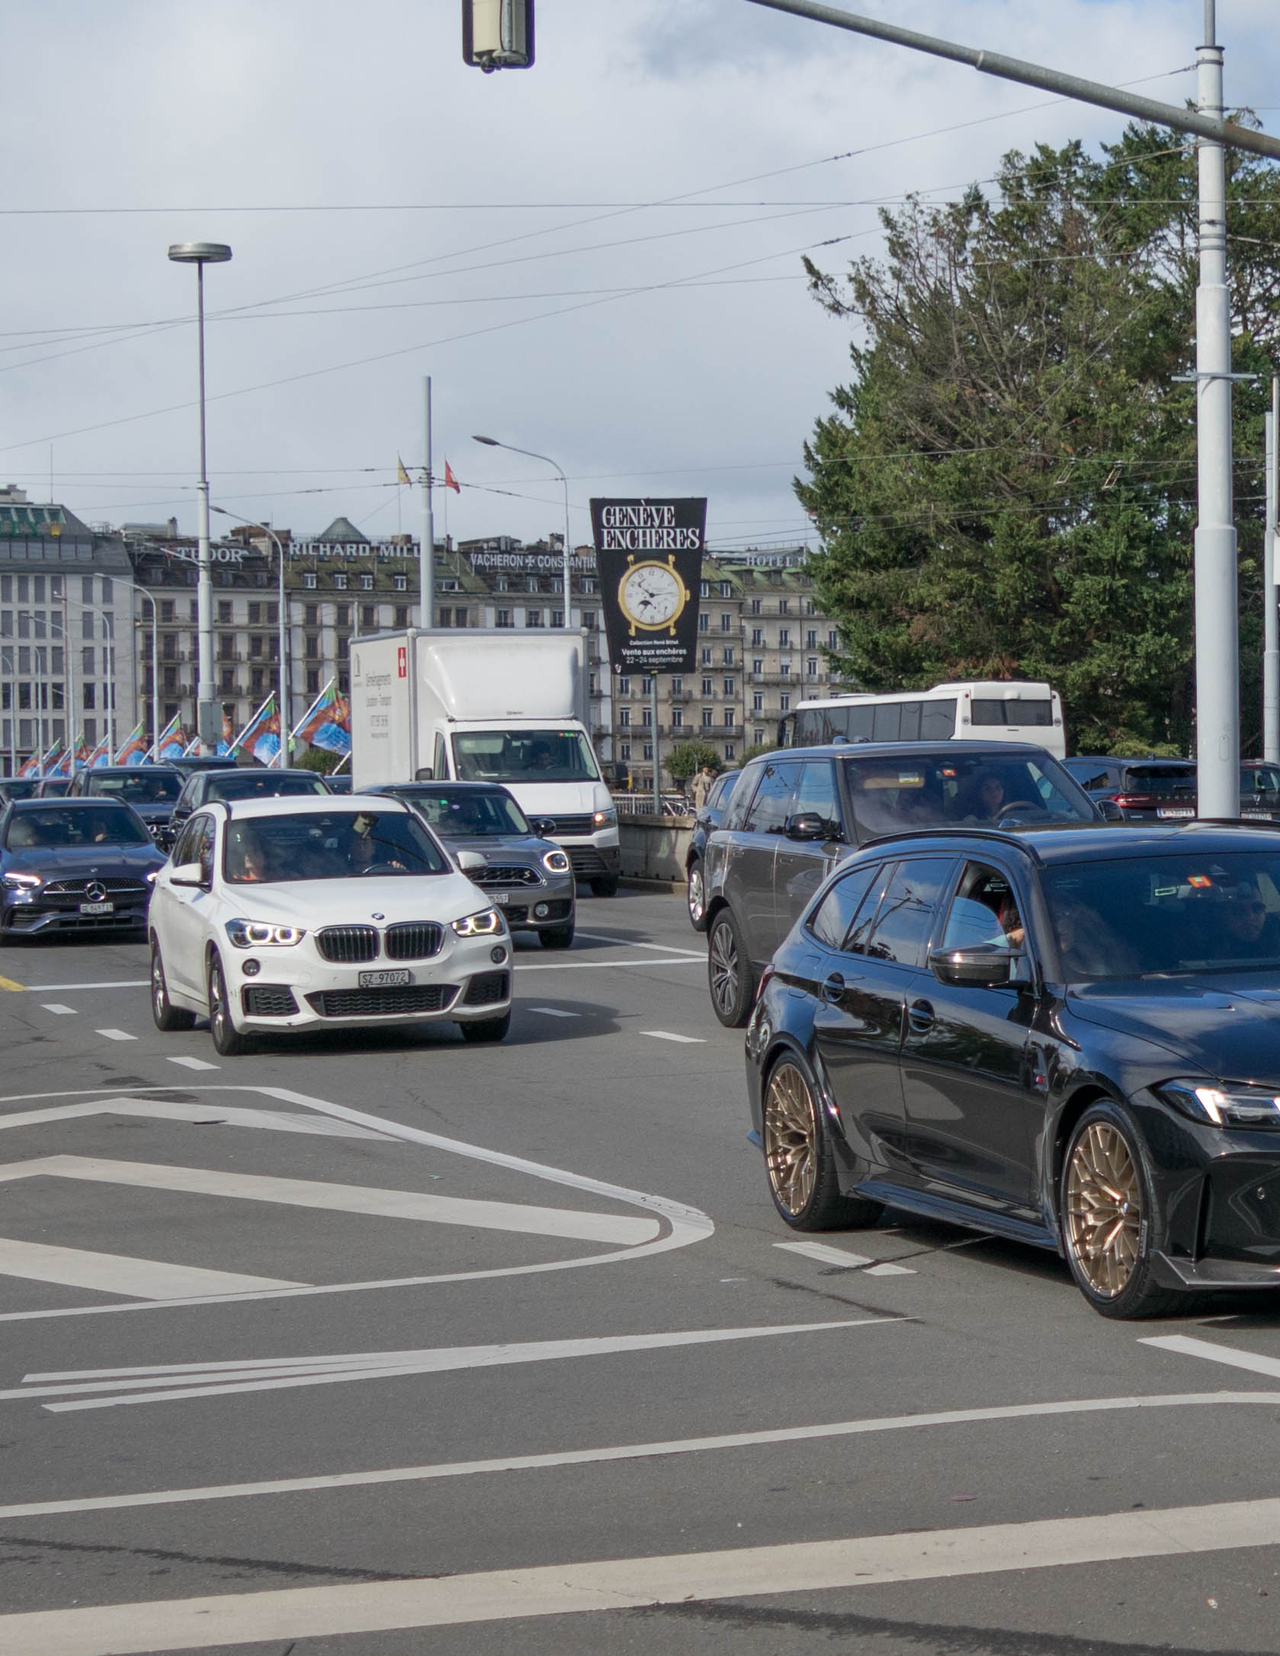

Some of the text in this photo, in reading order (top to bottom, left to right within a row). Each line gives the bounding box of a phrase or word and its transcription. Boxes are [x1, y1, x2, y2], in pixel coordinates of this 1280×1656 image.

[602, 500, 675, 528] GENÈVE
[288, 542, 421, 558] RICHARD MILL
[470, 553, 523, 567] VACHERON
[621, 648, 642, 656] Vente
[648, 656, 684, 664] septembre
[362, 971, 406, 984] SZ 97072
